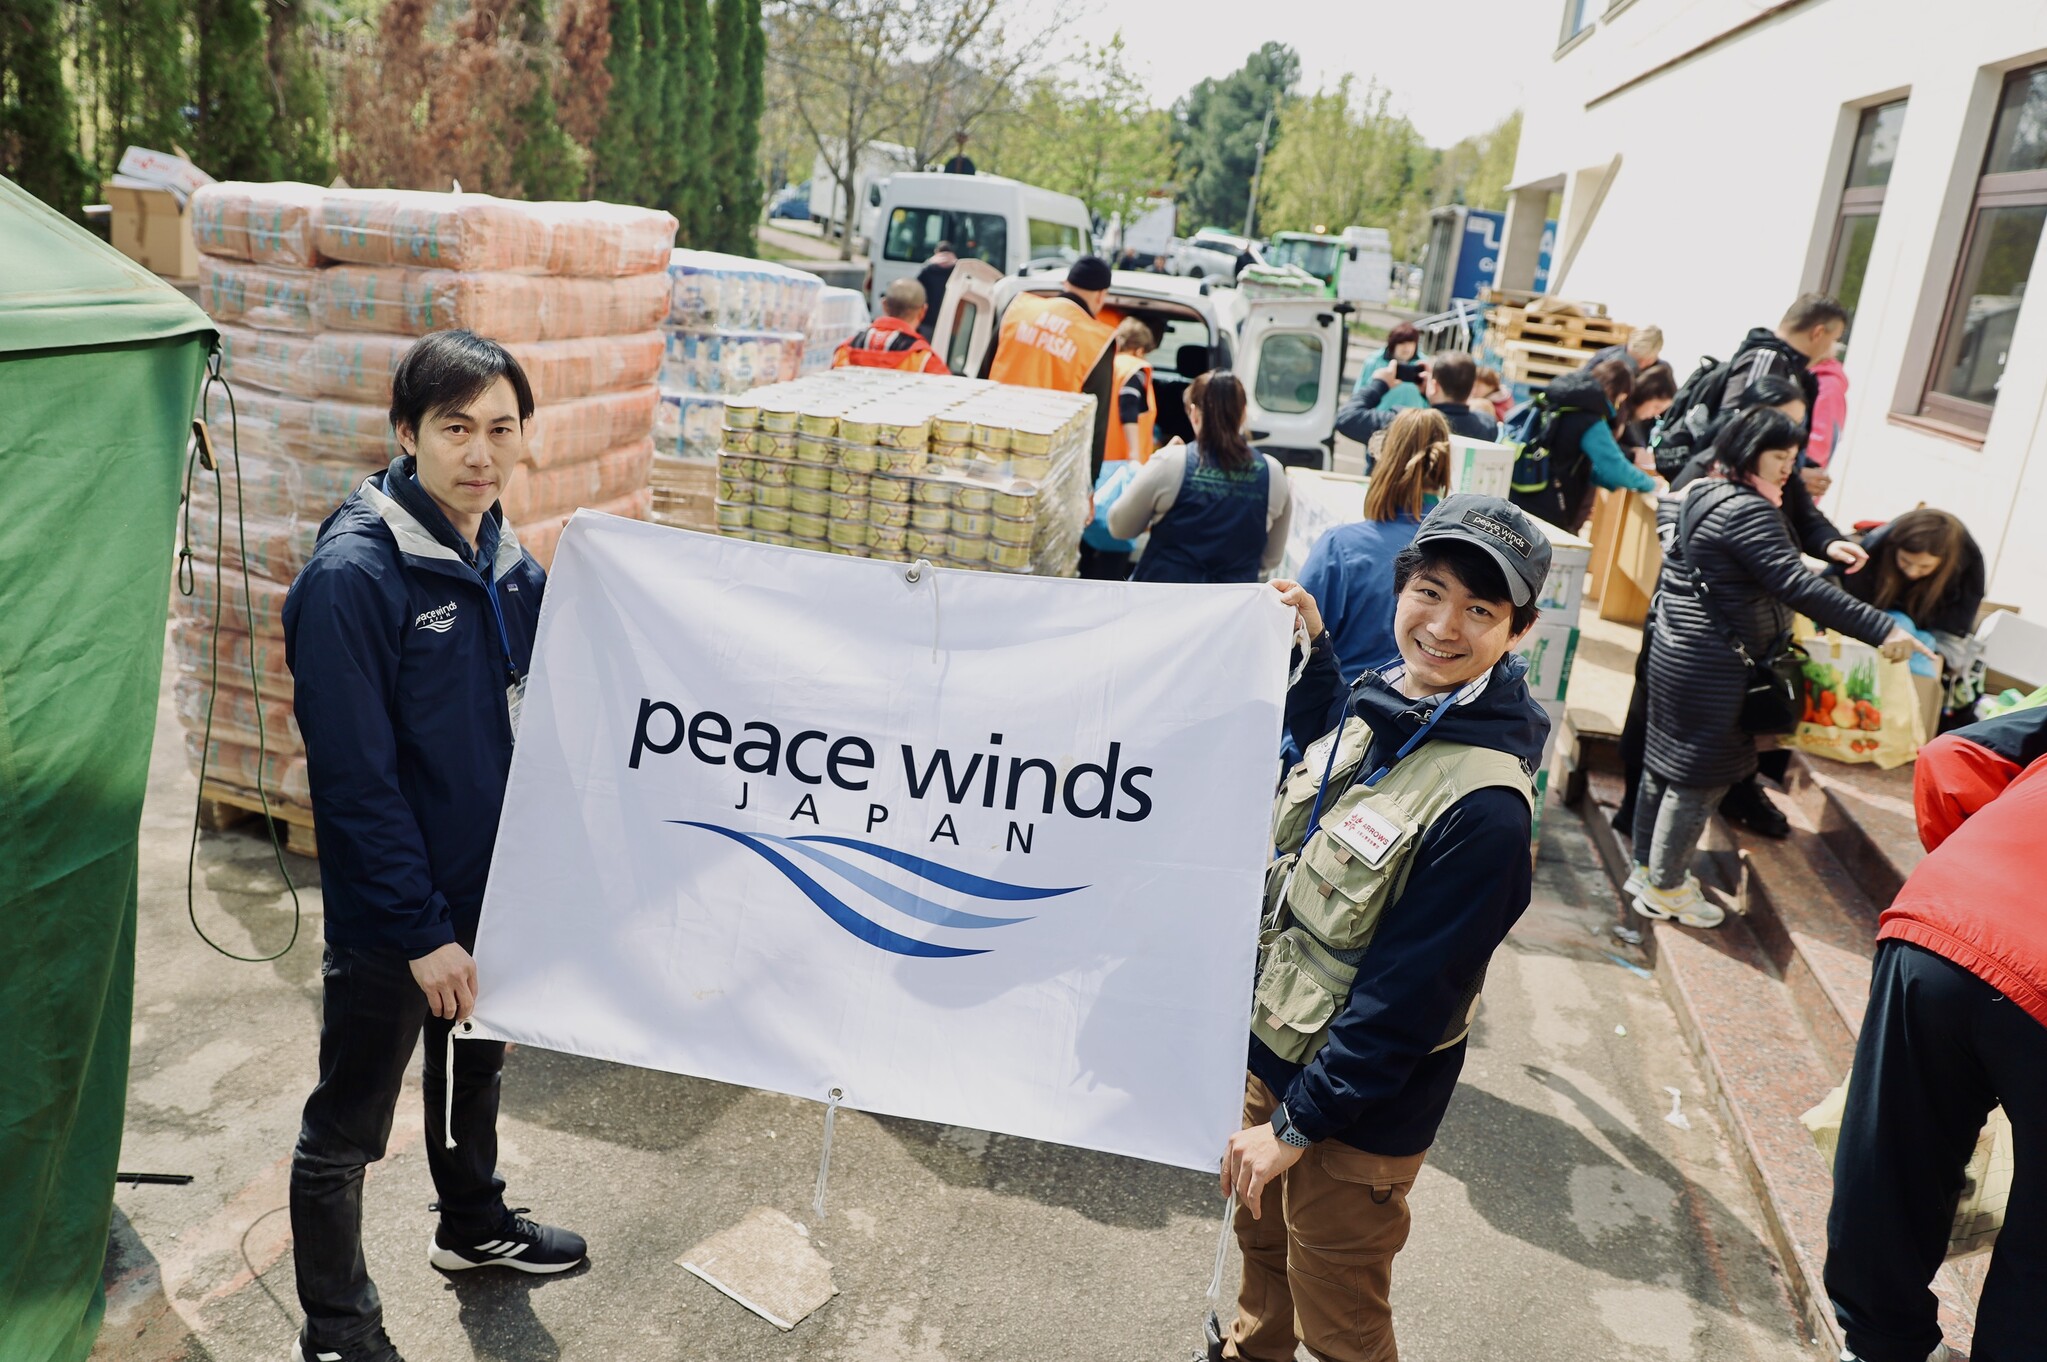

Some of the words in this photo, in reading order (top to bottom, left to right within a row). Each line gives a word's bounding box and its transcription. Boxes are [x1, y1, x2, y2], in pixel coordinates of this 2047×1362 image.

[1473, 516, 1501, 532] peace
[1501, 528, 1525, 548] winds
[435, 600, 457, 617] winds
[629, 697, 875, 791] peace
[901, 733, 1153, 822] winds
[735, 781, 1034, 854] JAPAN
[1362, 823, 1390, 846] ARROWS
